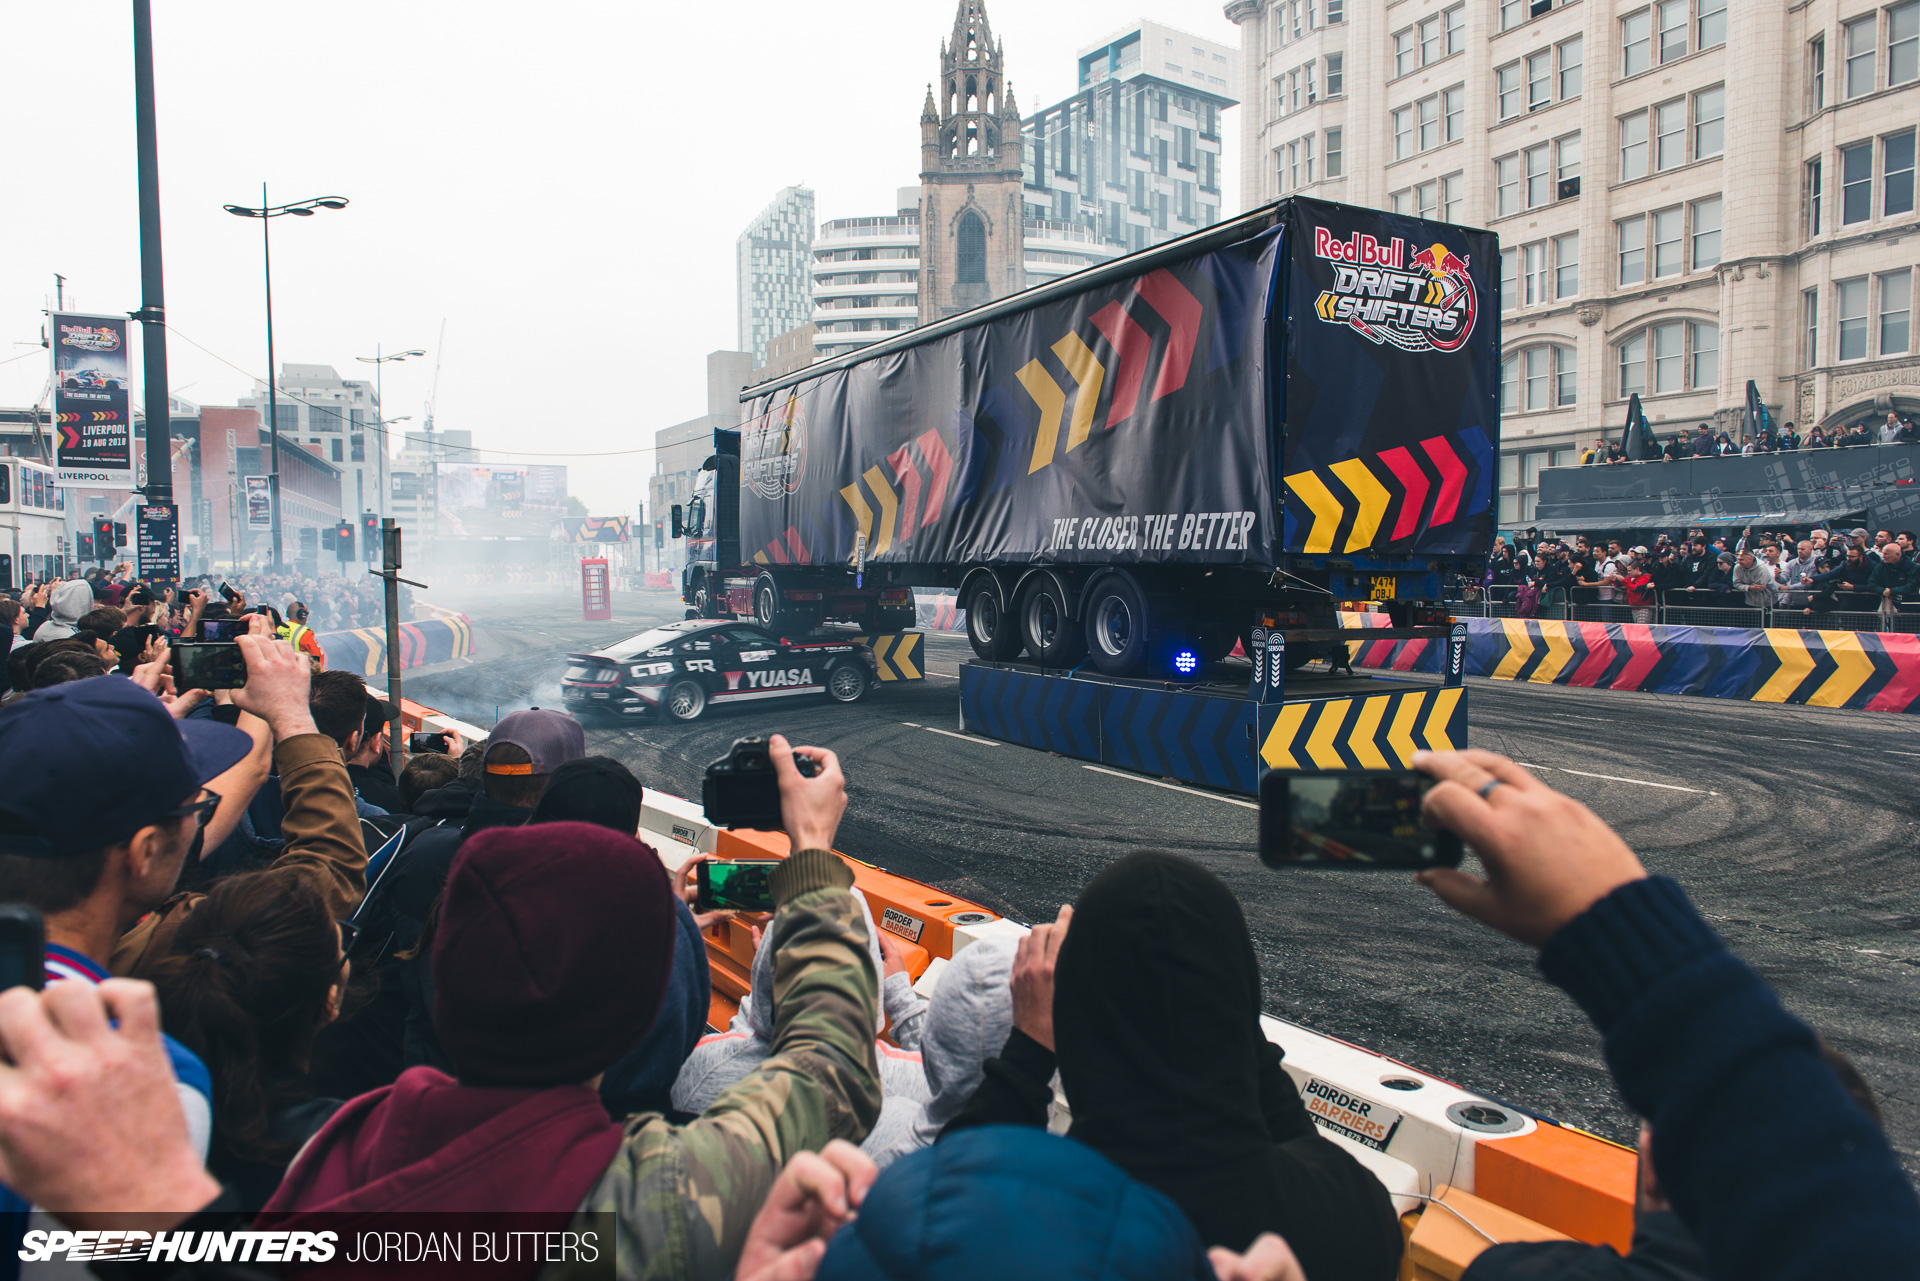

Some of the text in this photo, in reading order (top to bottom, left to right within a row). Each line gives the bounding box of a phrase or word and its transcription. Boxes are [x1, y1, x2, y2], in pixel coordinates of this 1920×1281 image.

[1315, 226, 1404, 269] Red Bull
[1336, 266, 1426, 302] DRIFT
[1335, 296, 1458, 330] SHIFTERS
[82, 425, 127, 436] LIVERPOOL
[82, 438, 127, 448] 19 AUG 2018
[58, 472, 110, 481] LIVERPOOL
[745, 453, 798, 481] SHIFTERS
[1843, 458, 1910, 487] GoPro
[1050, 511, 1256, 550] THE CLOSER THE BETTER
[646, 647, 675, 658] Ford
[746, 668, 813, 688] YUASA
[884, 909, 913, 928] BORDER
[885, 920, 918, 940] BARRIERS
[1306, 1081, 1372, 1118] BORDER
[1309, 1097, 1385, 1138] BARRIERS
